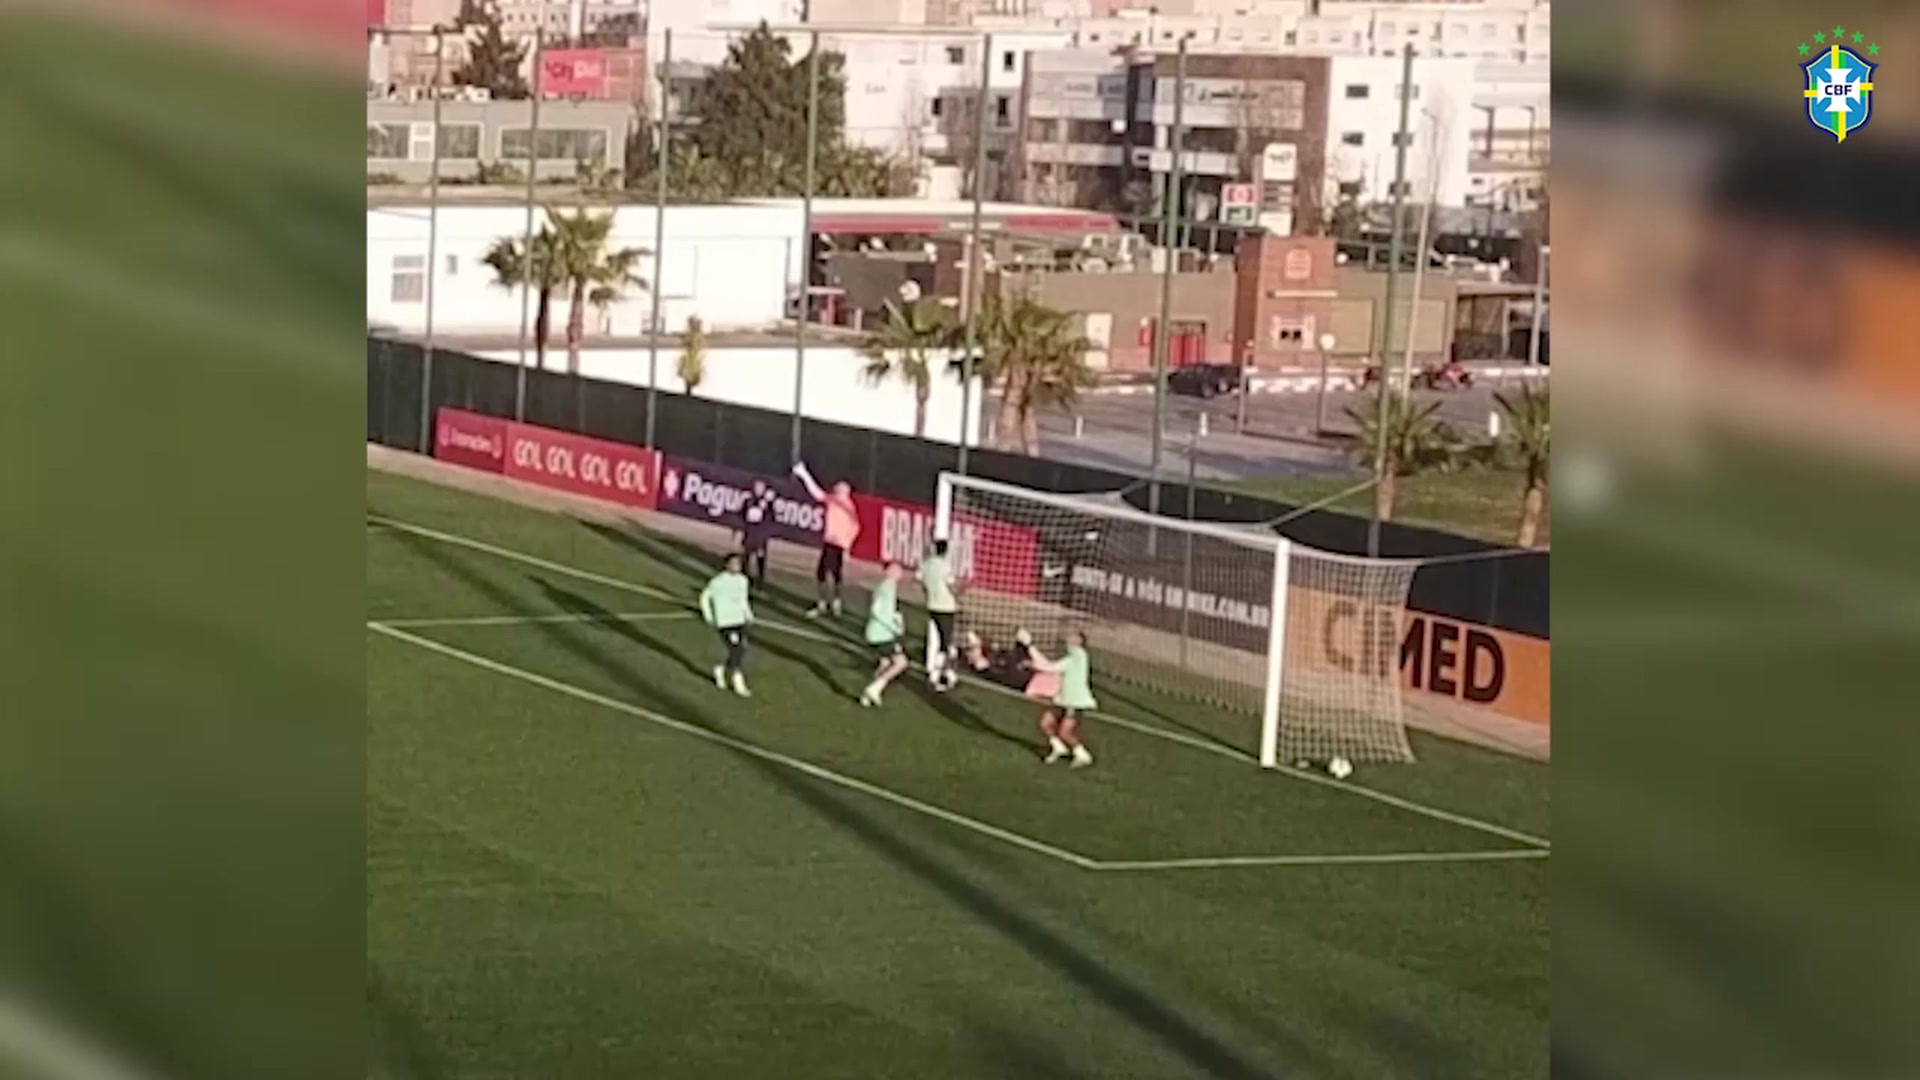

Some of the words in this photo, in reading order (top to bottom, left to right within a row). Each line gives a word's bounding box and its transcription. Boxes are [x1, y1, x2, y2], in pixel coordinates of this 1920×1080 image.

[513, 439, 542, 471] GOL
[546, 446, 576, 479] GOL
[579, 455, 610, 488] GOL
[614, 461, 648, 494] GOL
[764, 494, 825, 532] enos
[881, 506, 975, 580] BRAA
[1323, 601, 1505, 703] CIMED
